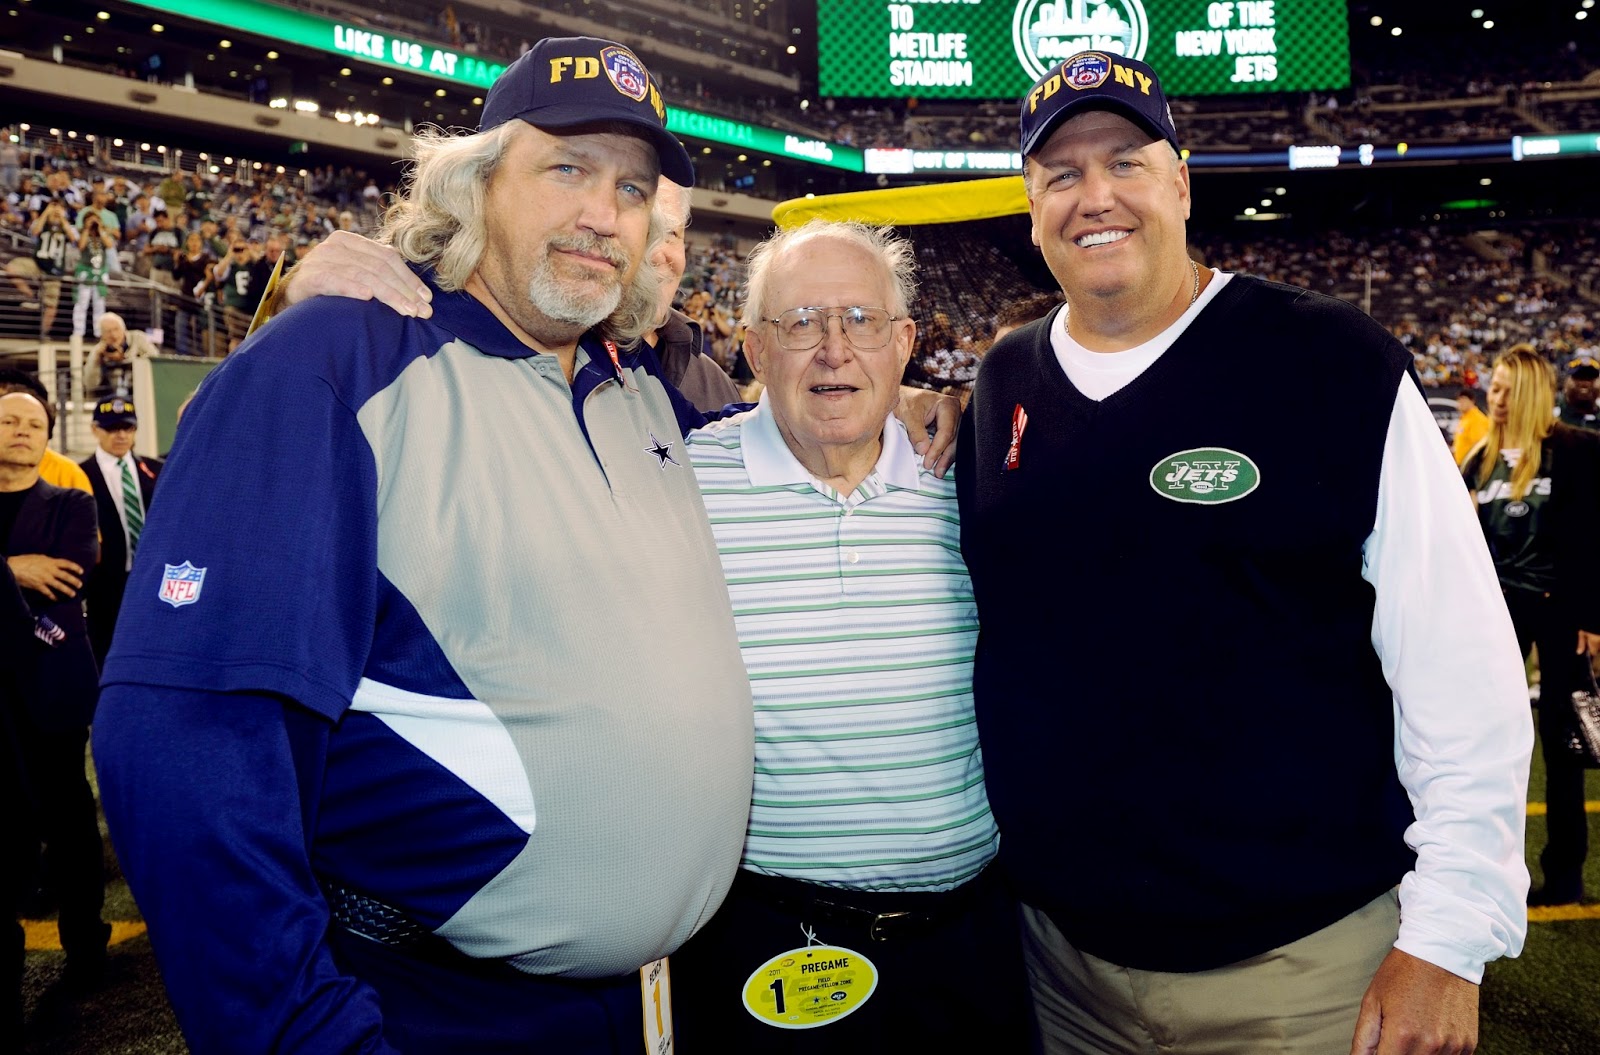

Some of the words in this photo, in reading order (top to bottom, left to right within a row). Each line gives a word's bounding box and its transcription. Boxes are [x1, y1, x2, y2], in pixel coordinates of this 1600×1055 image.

[888, 4, 914, 30] TO
[1207, 2, 1234, 28] OF
[1236, 0, 1276, 27] THE
[334, 25, 385, 59] LIKE
[392, 40, 423, 69] US
[429, 50, 458, 75] AT
[463, 57, 508, 82] FAC
[889, 32, 968, 59] METLIFE
[1175, 30, 1223, 57] NEW
[1224, 28, 1278, 55] YORK
[550, 56, 600, 83] FD
[890, 60, 973, 87] STADIUM
[1230, 55, 1278, 82] JETS
[1029, 75, 1061, 114] FD
[1113, 64, 1152, 96] NY
[913, 152, 944, 169] OUT
[944, 152, 966, 169] OF
[966, 152, 1011, 169] TOWN
[1165, 465, 1239, 482] JETS
[163, 580, 195, 601] NFL
[801, 957, 849, 975] PREGAME
[769, 978, 786, 1014] 1
[798, 981, 839, 993] PREGAME-YELLOW
[840, 978, 852, 986] ZONE
[653, 979, 664, 1038] 1
